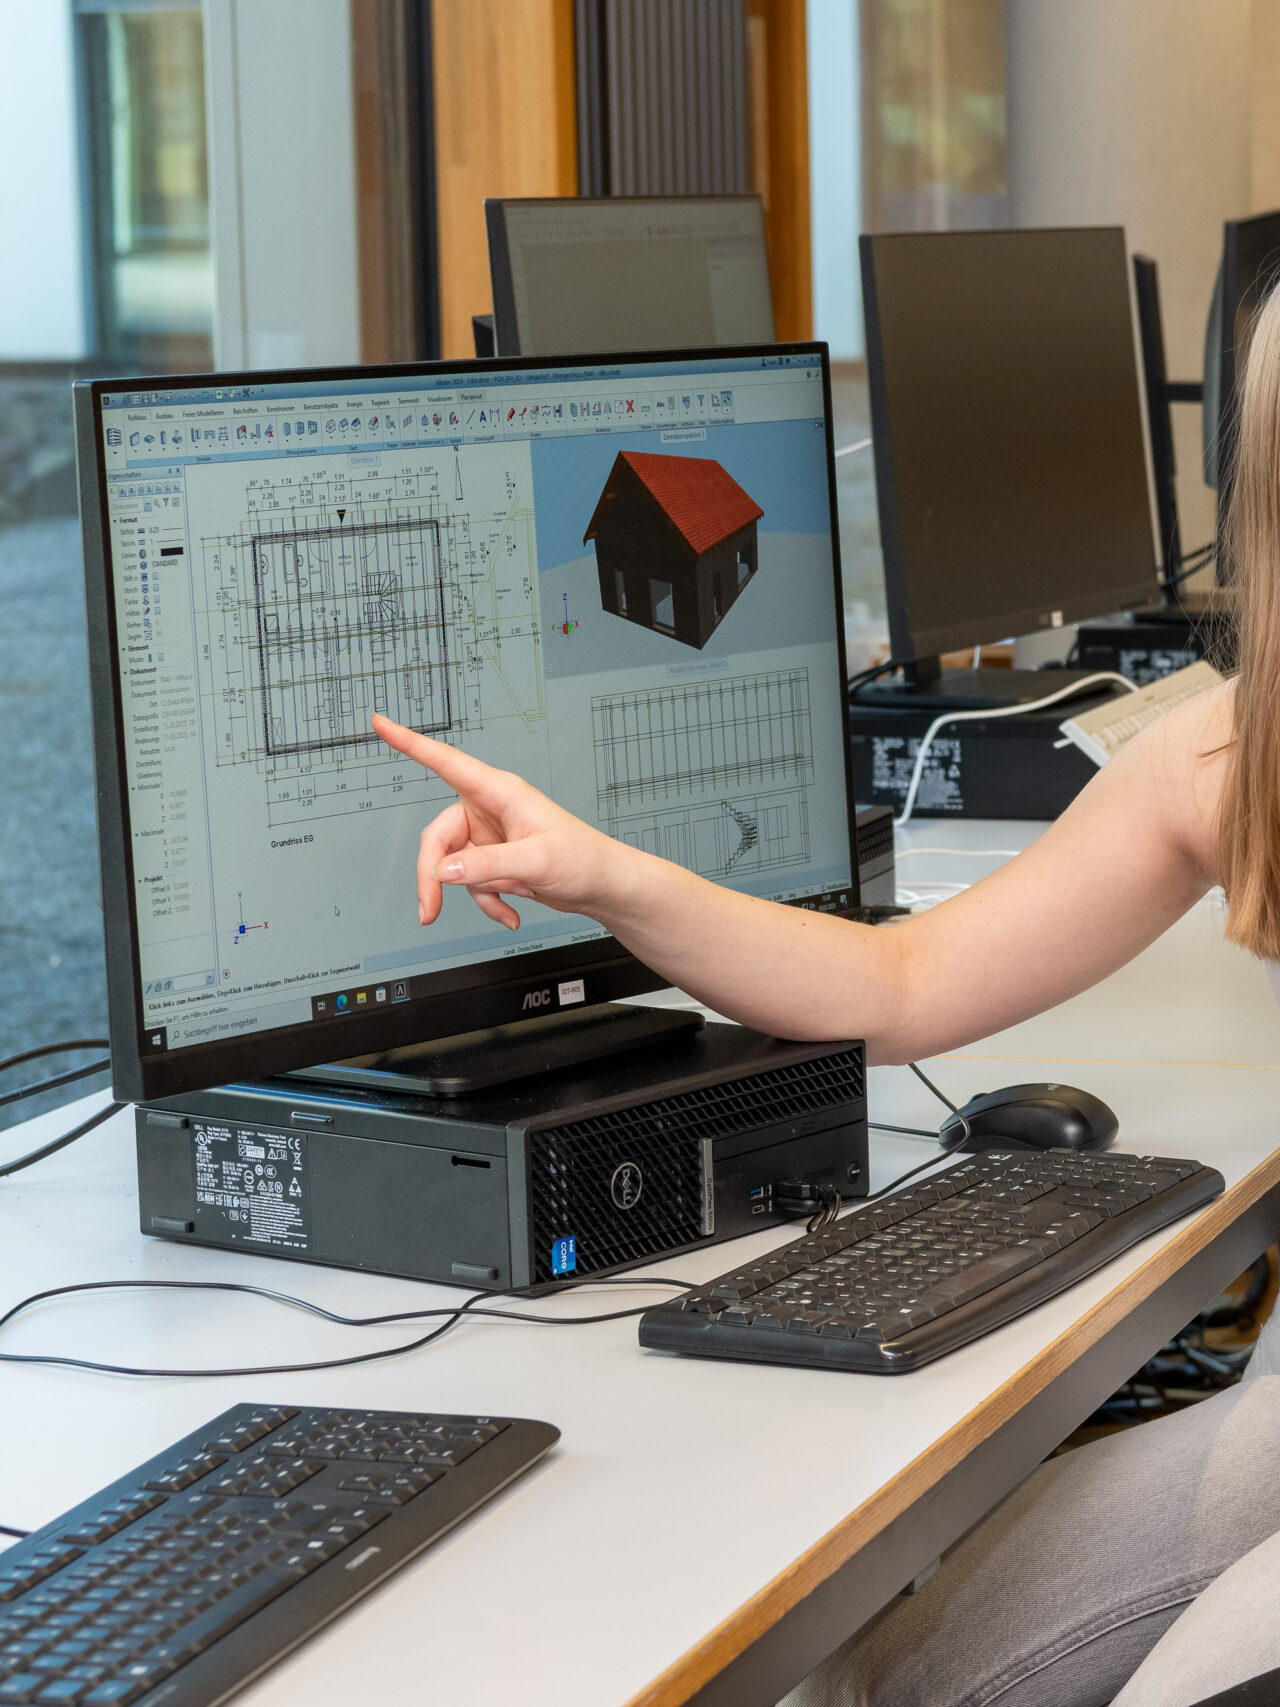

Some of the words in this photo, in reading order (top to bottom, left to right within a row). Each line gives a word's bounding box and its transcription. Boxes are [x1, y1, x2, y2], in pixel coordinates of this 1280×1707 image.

[232, 407, 259, 415] Beschriften
[267, 405, 295, 413] Konstruieren
[453, 444, 459, 452] N
[355, 491, 362, 499] 24
[151, 559, 178, 568] STANDARD
[128, 644, 149, 652] Element
[130, 667, 157, 675] Dokument
[131, 679, 156, 687] Dokument
[131, 690, 156, 699] Dokument
[392, 774, 403, 782] 4.01
[335, 783, 347, 791] 3.49
[392, 785, 404, 793] 2.26
[270, 836, 303, 849] Grundriss
[303, 834, 314, 844] EG
[144, 875, 163, 884] Projekt
[517, 943, 543, 954] Deutschland
[148, 1002, 162, 1011] Klick
[162, 1000, 175, 1009] links
[175, 999, 186, 1007] zum
[243, 985, 253, 993] zum
[321, 970, 329, 978] zur
[329, 963, 361, 976] Segmentwahl
[522, 989, 551, 1010] AOC
[165, 1016, 173, 1025] Sie
[190, 1011, 201, 1019] Hilfe
[208, 1006, 229, 1016] erhalten.
[184, 1026, 217, 1039] Suchbegriff
[217, 1021, 230, 1031] hier
[231, 1017, 258, 1030] eingeben
[622, 1168, 633, 1206] DELL
